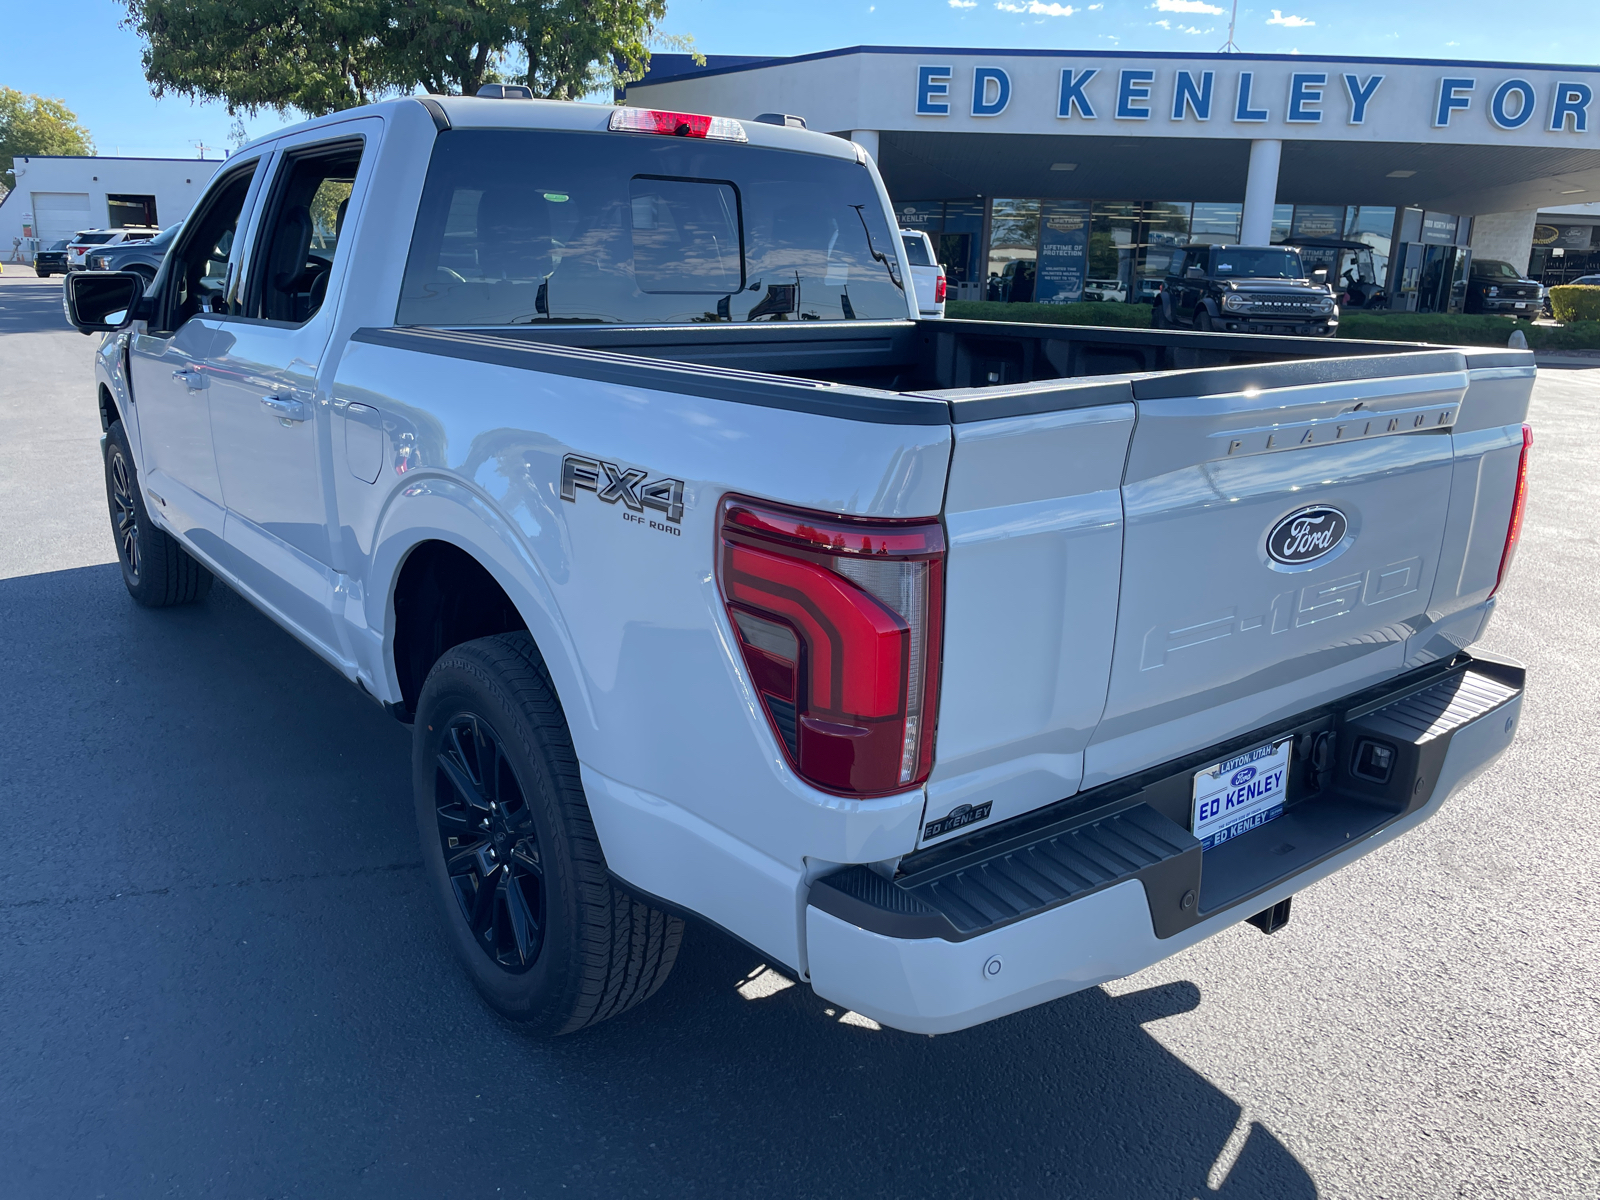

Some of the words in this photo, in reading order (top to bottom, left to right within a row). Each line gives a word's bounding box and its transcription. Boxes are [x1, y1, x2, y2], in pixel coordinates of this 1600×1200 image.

[914, 64, 1012, 118] ED
[1056, 66, 1385, 125] KENLEY
[1432, 76, 1594, 133] FOR
[901, 214, 929, 222] KENLEY
[1227, 412, 1451, 455] PLATINUM
[560, 453, 685, 525] FX4
[622, 512, 645, 525] OFF
[649, 520, 681, 537] ROAD
[1283, 514, 1336, 557] Ford
[1139, 555, 1423, 672] F-150
[1220, 754, 1251, 774] LAYTON,
[1252, 744, 1271, 760] UTAH
[1235, 769, 1253, 785] Ford
[1199, 797, 1220, 821] ED
[1226, 770, 1283, 810] KENLEY
[924, 823, 941, 837] ED
[944, 805, 991, 830] KENLEY
[1214, 831, 1228, 845] ED
[1230, 811, 1268, 837] KENLEY
